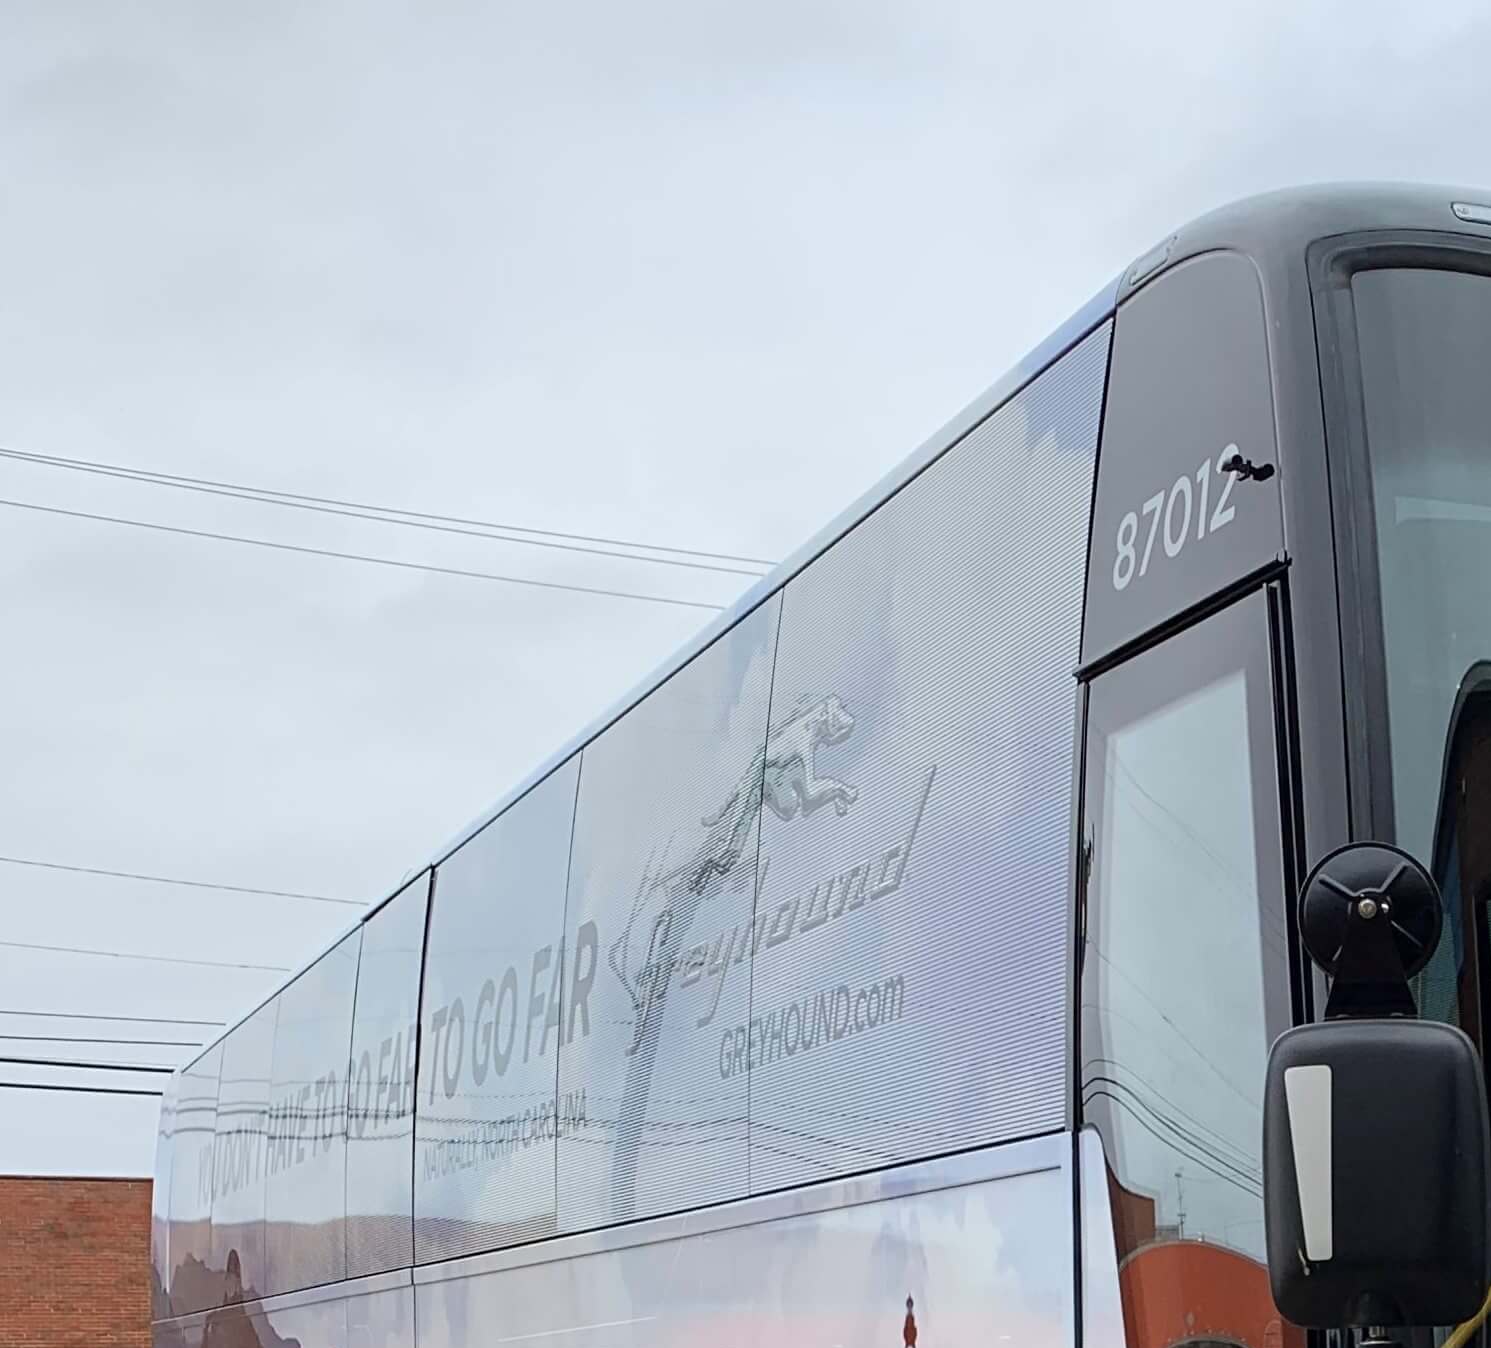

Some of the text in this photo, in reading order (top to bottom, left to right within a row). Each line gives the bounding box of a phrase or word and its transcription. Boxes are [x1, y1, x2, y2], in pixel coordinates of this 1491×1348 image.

[1112, 442, 1241, 592] 87012
[312, 1069, 337, 1157] TO
[429, 997, 465, 1106] TO
[472, 966, 518, 1088] GO
[523, 919, 599, 1064] FAR
[719, 973, 905, 1081] GREYHOUND.com
